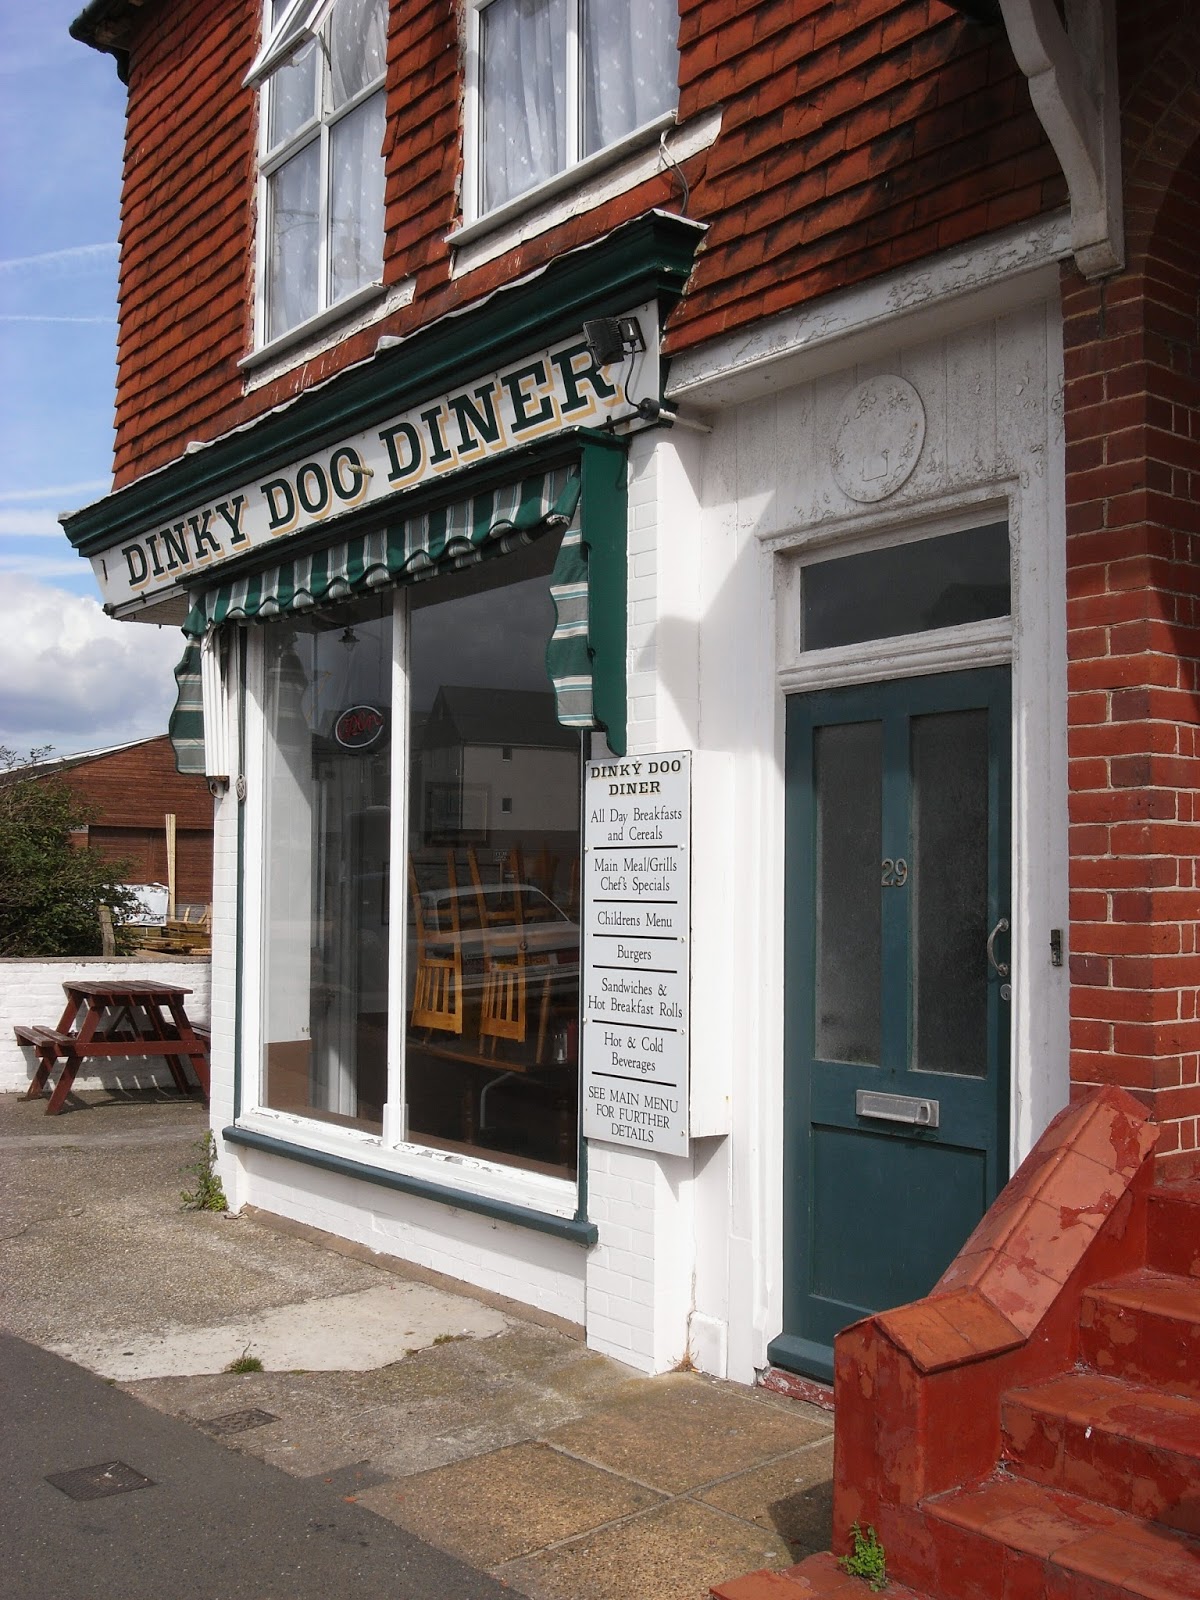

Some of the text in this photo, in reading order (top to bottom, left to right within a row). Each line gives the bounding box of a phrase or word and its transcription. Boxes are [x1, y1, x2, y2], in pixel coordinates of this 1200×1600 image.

[121, 340, 619, 588] DINKY DOO DINER
[590, 759, 682, 779] DINKY DOO
[608, 781, 661, 796] DINER
[590, 805, 683, 826] All Day Breakfasts
[607, 825, 664, 842] and Cereals
[594, 856, 678, 874] Main Meal/Grills
[881, 858, 908, 887] 29
[632, 876, 671, 895] Specials
[597, 911, 673, 928] Childrens Menu
[616, 944, 652, 964] Burgers
[601, 977, 668, 997] Sandwiches &
[587, 995, 684, 1019] Hot Breakfast Rolls
[603, 1031, 664, 1053] Hot & Cold
[611, 1051, 656, 1073] Beverages
[588, 1085, 679, 1114] SEE MAIN MENU
[596, 1103, 670, 1129] FOR FURTHER
[611, 1122, 654, 1143] DETAILS
